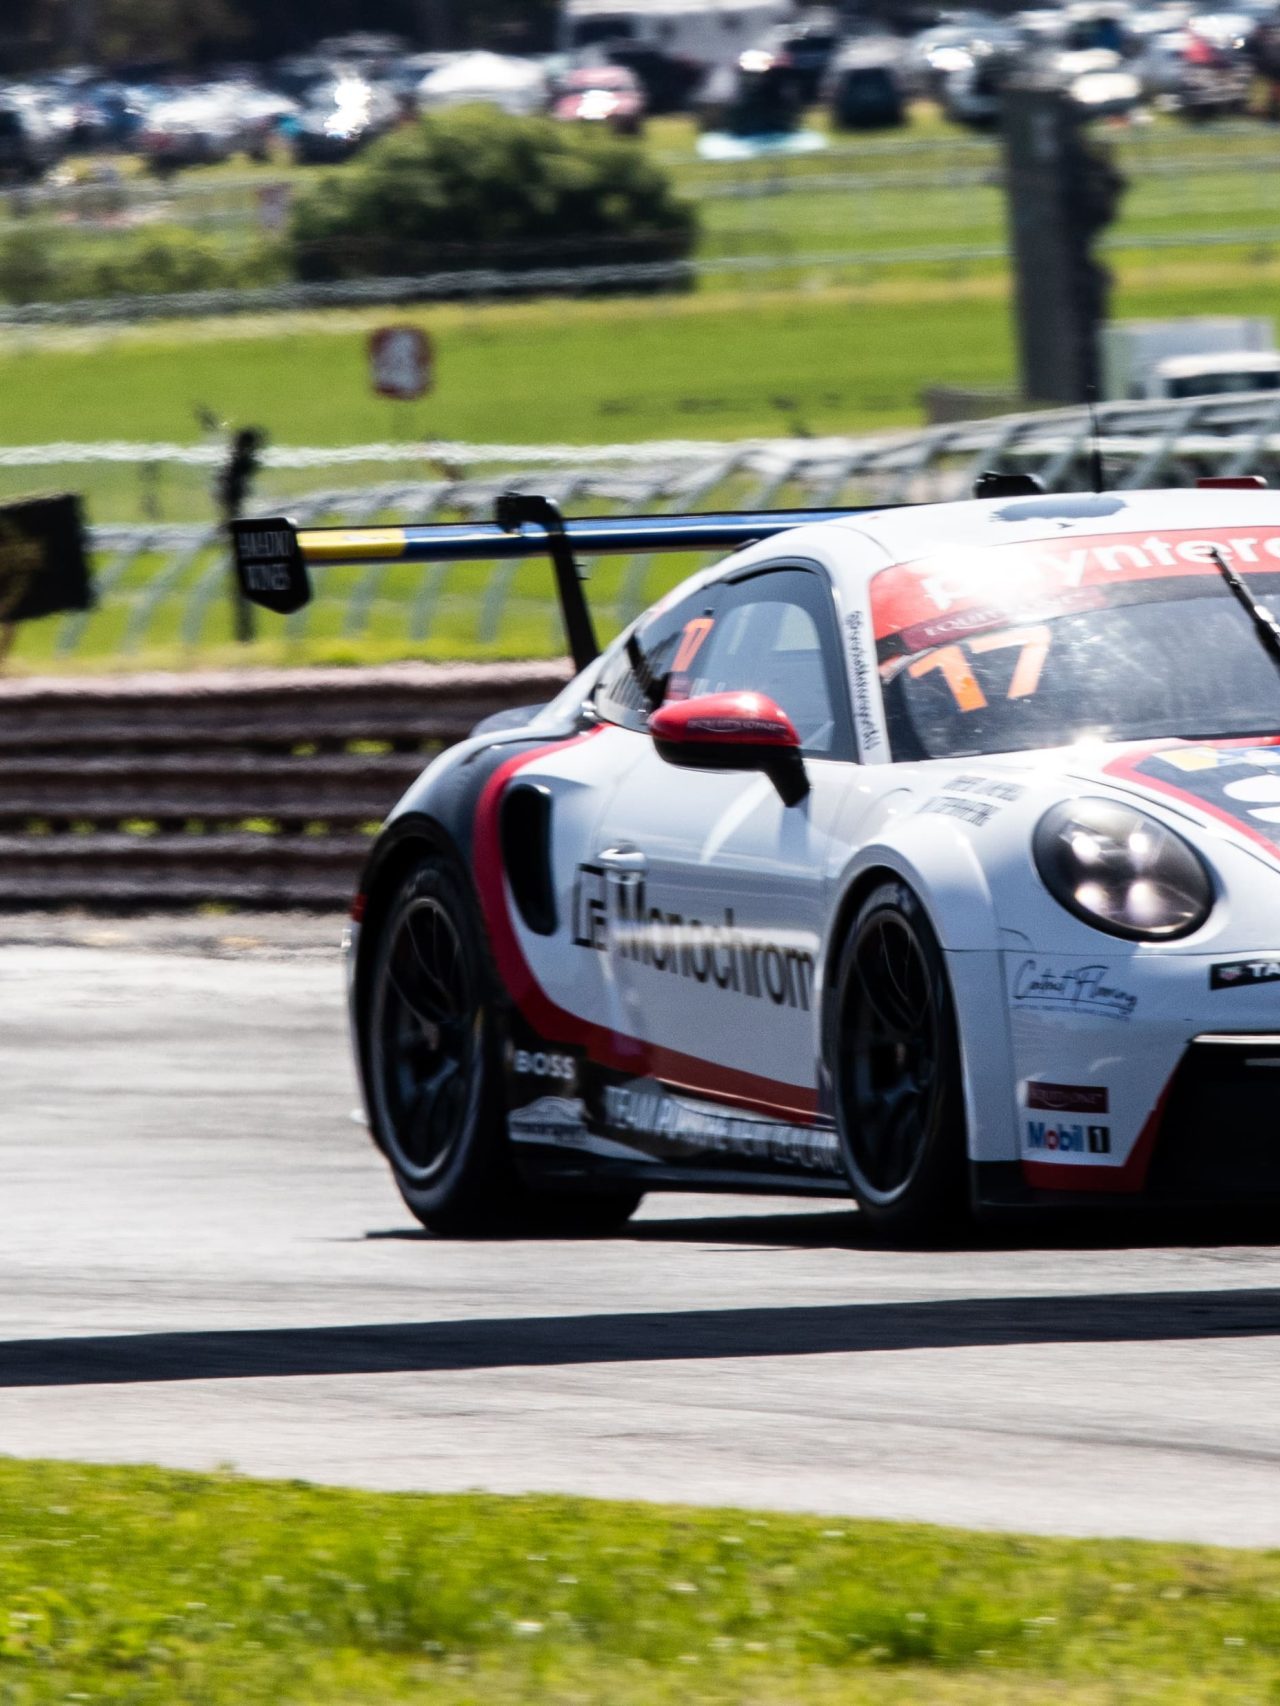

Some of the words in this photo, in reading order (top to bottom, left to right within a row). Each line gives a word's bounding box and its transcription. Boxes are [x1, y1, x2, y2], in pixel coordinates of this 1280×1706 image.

[908, 624, 1051, 713] 17
[514, 1050, 576, 1079] BOSS
[1027, 1120, 1086, 1152] Mobil
